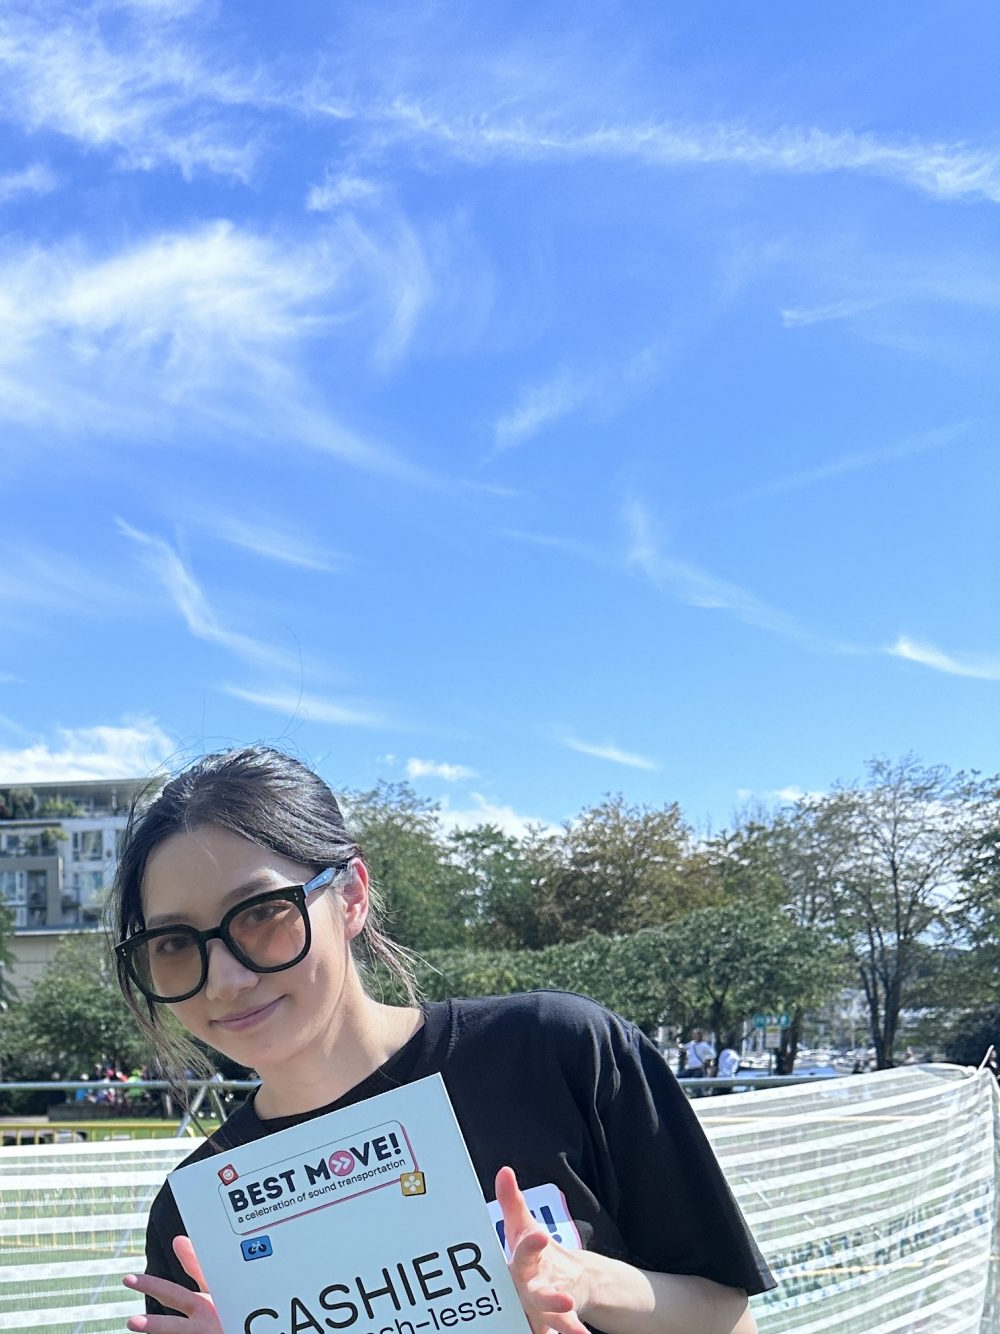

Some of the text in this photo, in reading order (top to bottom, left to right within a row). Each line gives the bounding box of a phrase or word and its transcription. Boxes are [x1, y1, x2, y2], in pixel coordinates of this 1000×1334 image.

[228, 1132, 402, 1213] BEST MOVE!
[237, 1158, 406, 1224] a celebration of sound transportation
